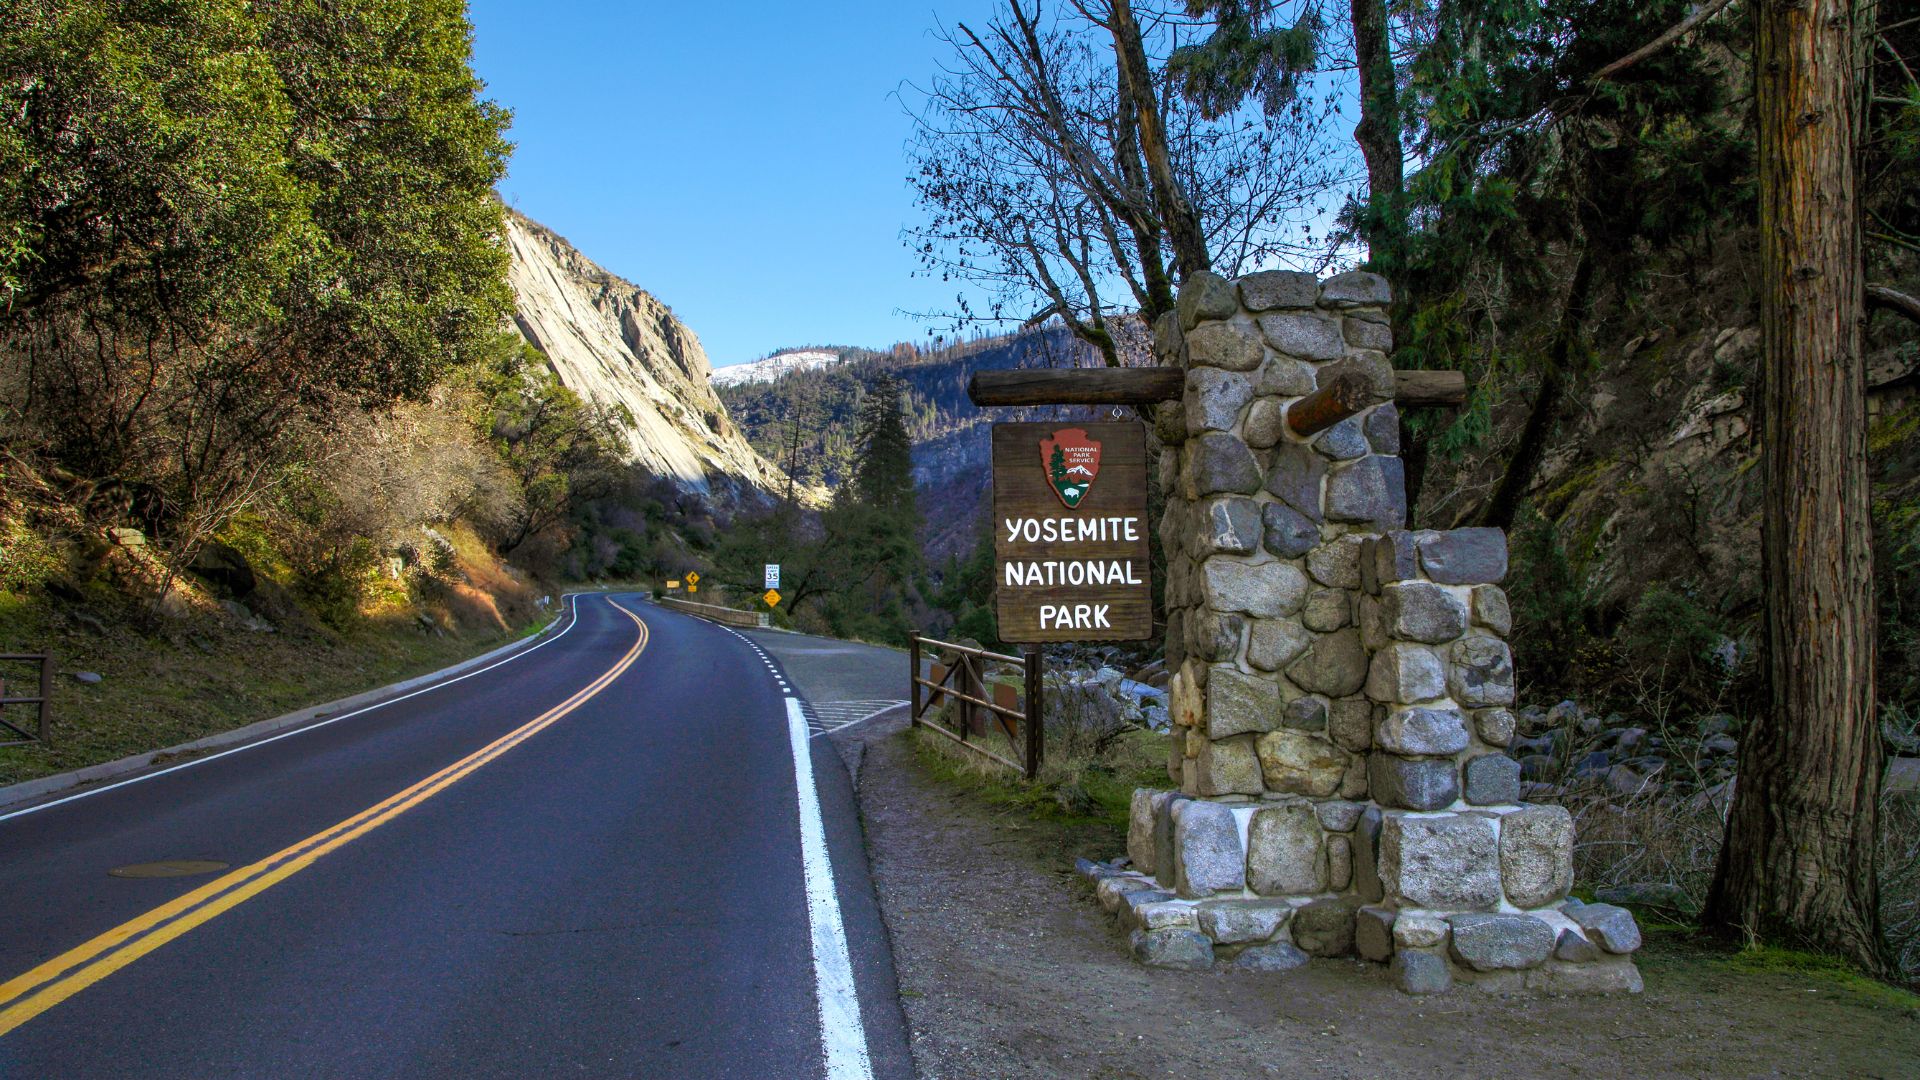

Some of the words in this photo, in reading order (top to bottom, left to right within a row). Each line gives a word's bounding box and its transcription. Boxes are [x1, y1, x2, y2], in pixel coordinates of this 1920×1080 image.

[1005, 517, 1139, 542] YOSEMITE
[1005, 560, 1142, 586] NATIONAL
[1040, 604, 1111, 629] PARK
